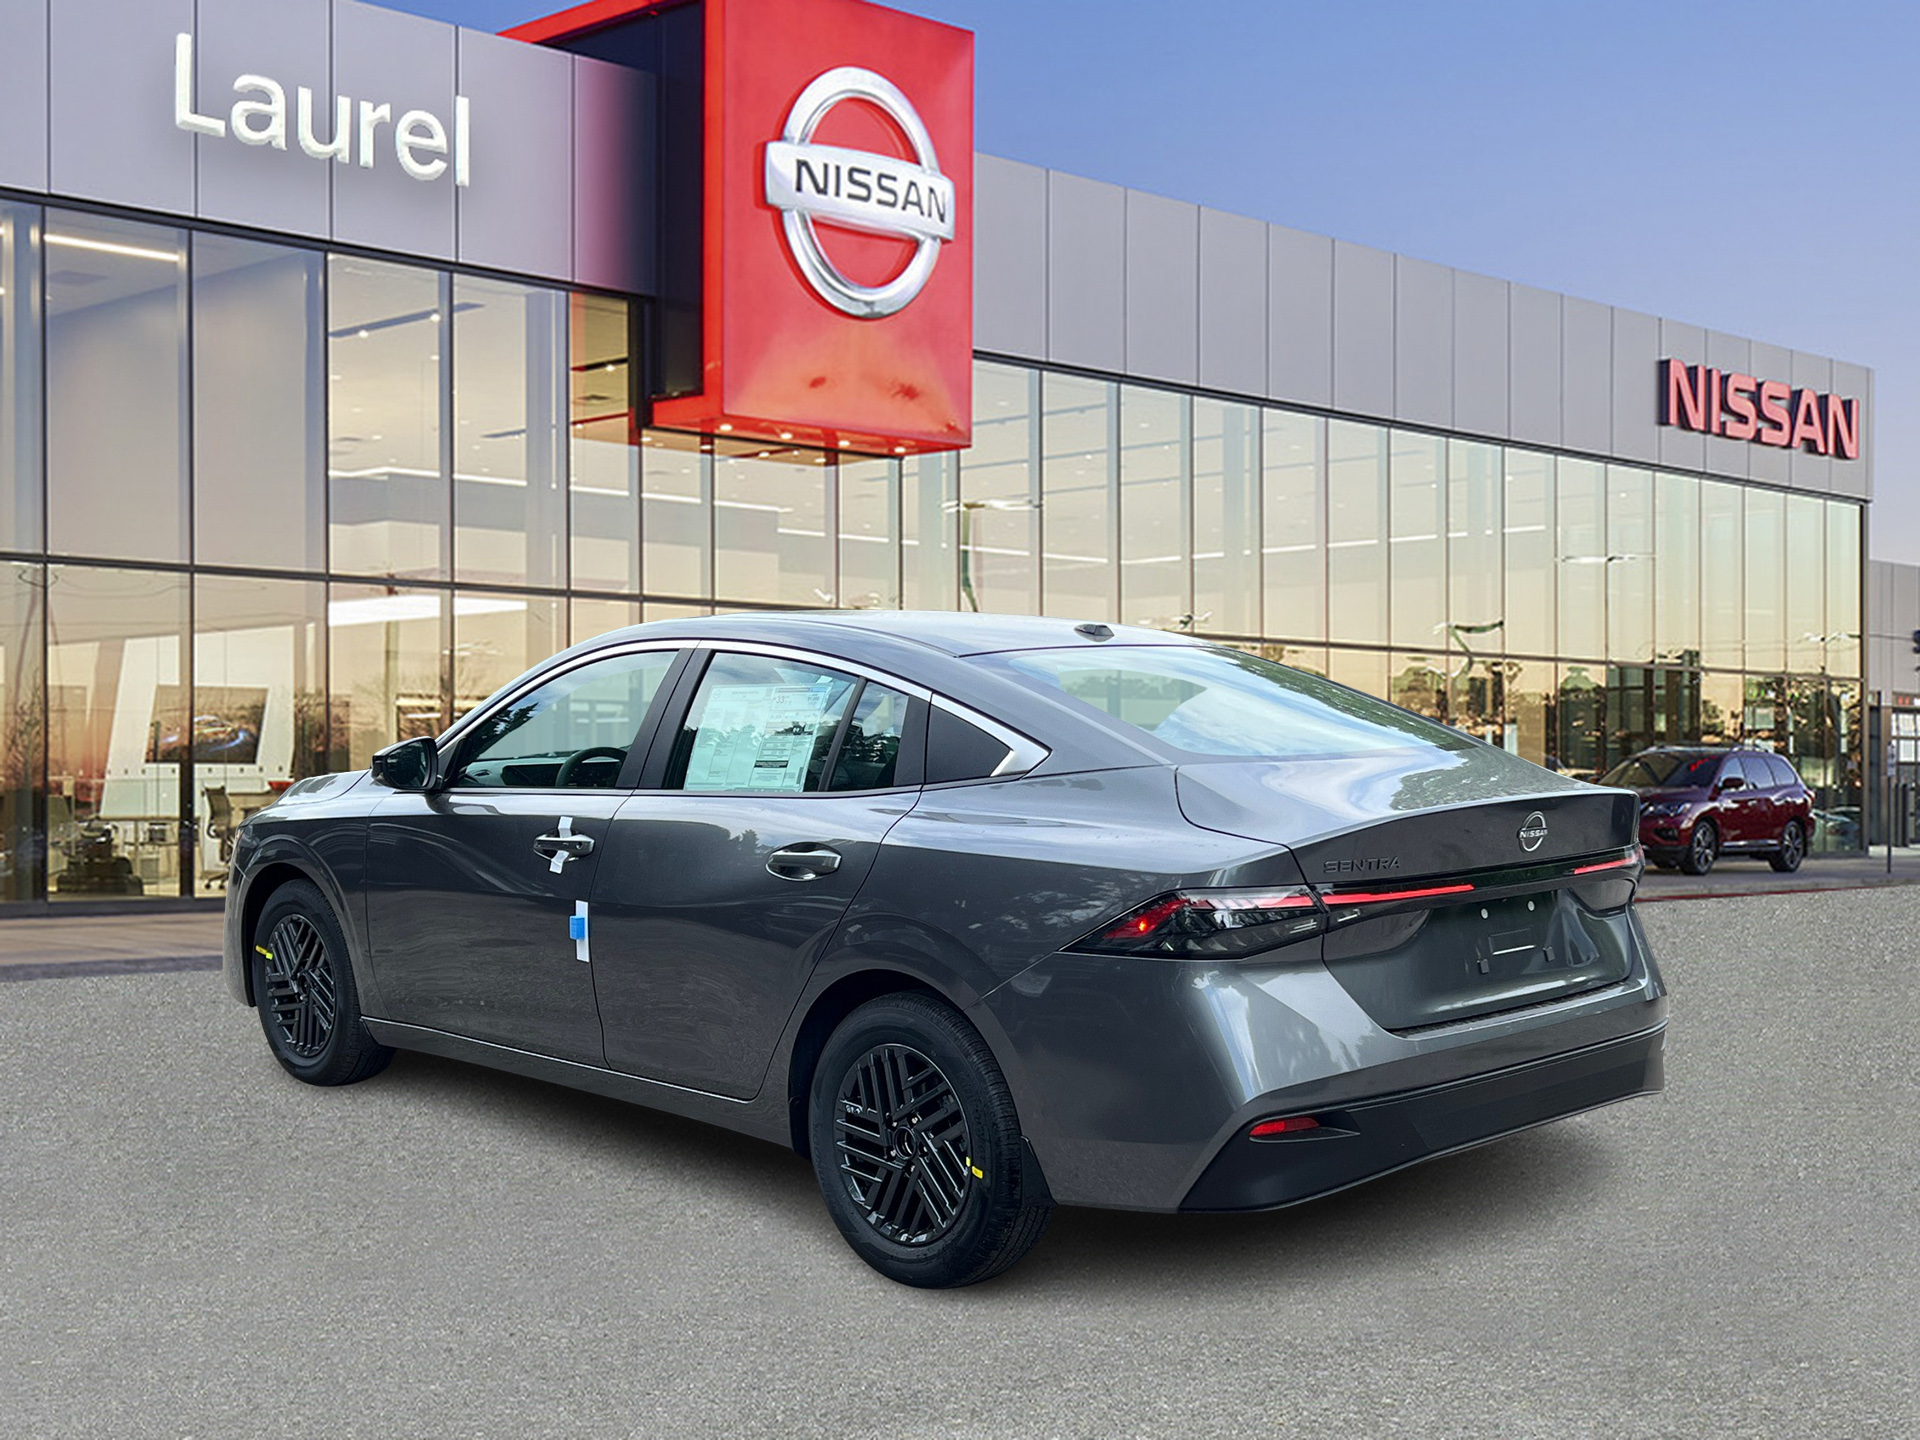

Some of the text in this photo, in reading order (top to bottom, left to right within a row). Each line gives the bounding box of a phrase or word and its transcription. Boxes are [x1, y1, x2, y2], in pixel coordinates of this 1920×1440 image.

[175, 32, 470, 188] Laurel
[794, 157, 947, 224] NISSAN
[1660, 358, 1860, 460] NISSAN
[1323, 856, 1399, 874] SENTRA
